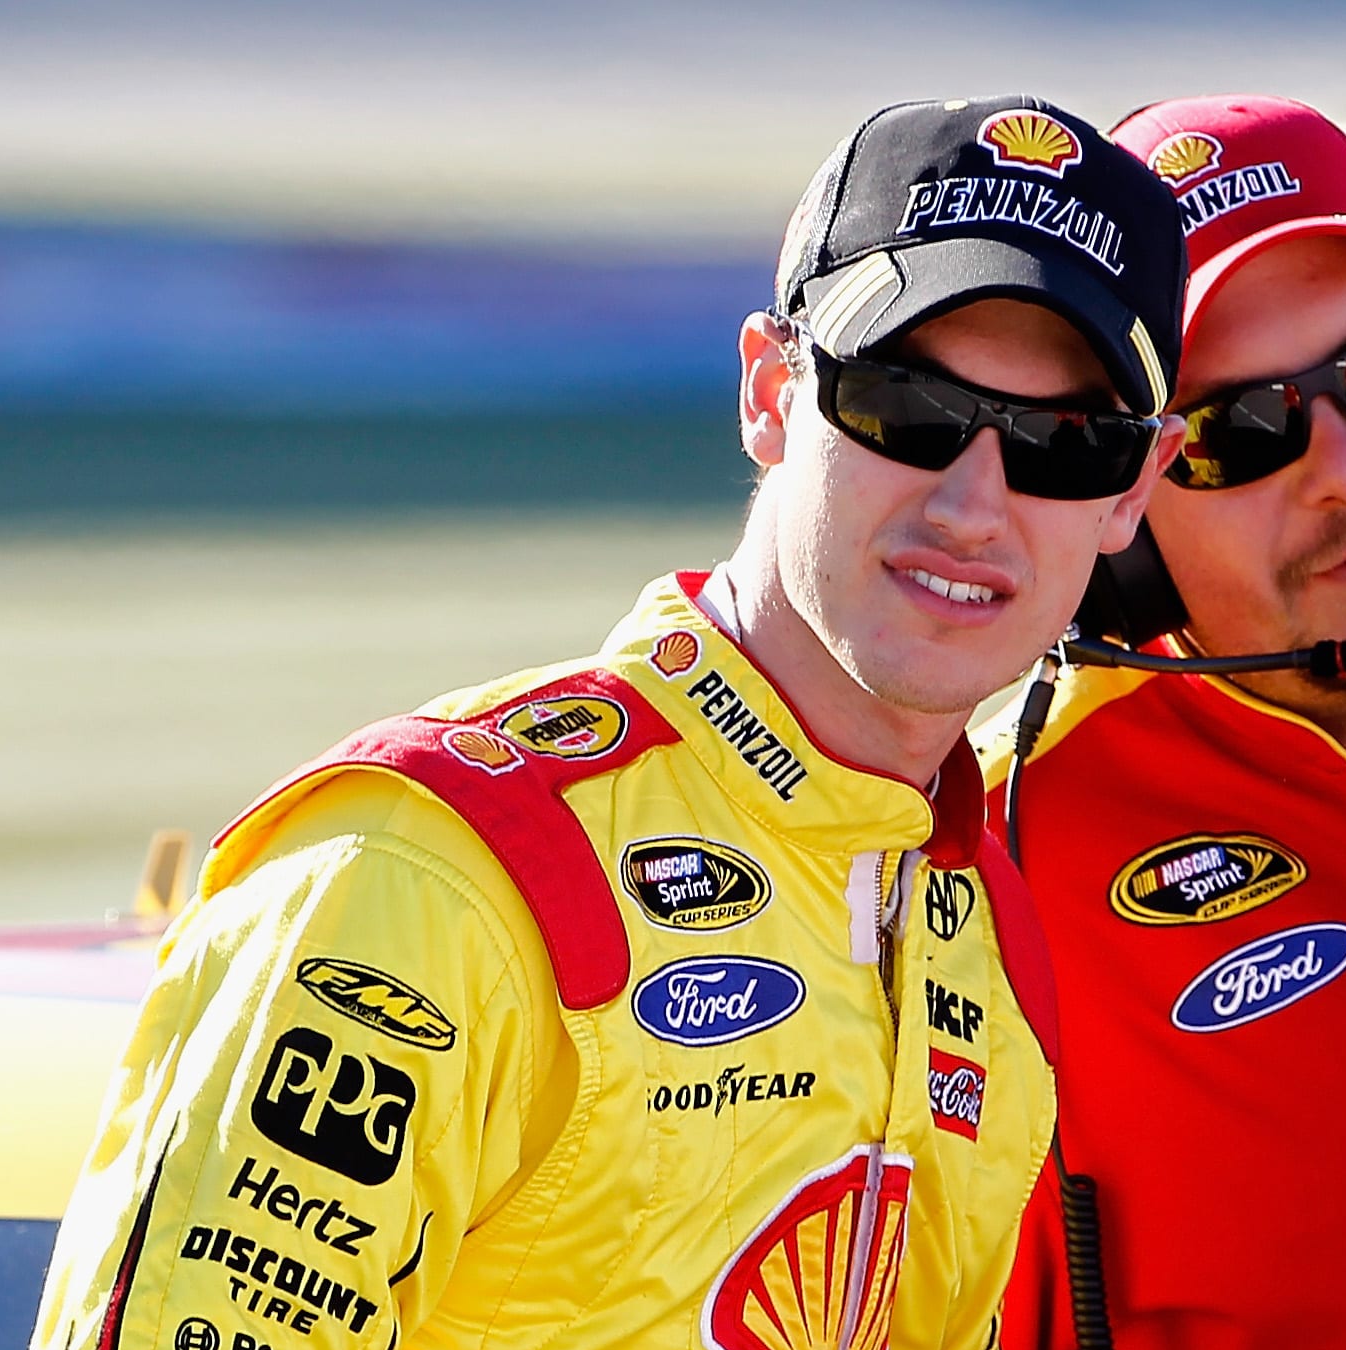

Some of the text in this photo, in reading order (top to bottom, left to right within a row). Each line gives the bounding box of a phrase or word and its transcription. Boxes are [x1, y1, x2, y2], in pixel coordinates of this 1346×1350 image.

[896, 176, 1127, 276] PENNZOIL
[1176, 161, 1301, 238] NNZOIL
[519, 705, 603, 746] PENNZOIL
[686, 669, 809, 803] PENNZOIL
[645, 853, 698, 881] NASCAR
[658, 876, 714, 907] Sprint
[1161, 847, 1223, 886] NASCAR
[1179, 862, 1246, 902] Sprint
[673, 903, 752, 926] CUP SERIES
[664, 968, 758, 1025] Ford
[1215, 944, 1324, 1018] Ford
[266, 1046, 407, 1155] PPG
[647, 1067, 817, 1116] OODYEAR
[228, 1157, 378, 1257] Hertz
[180, 1225, 379, 1334] DISCOUNT
[229, 1277, 321, 1335] TIRE
